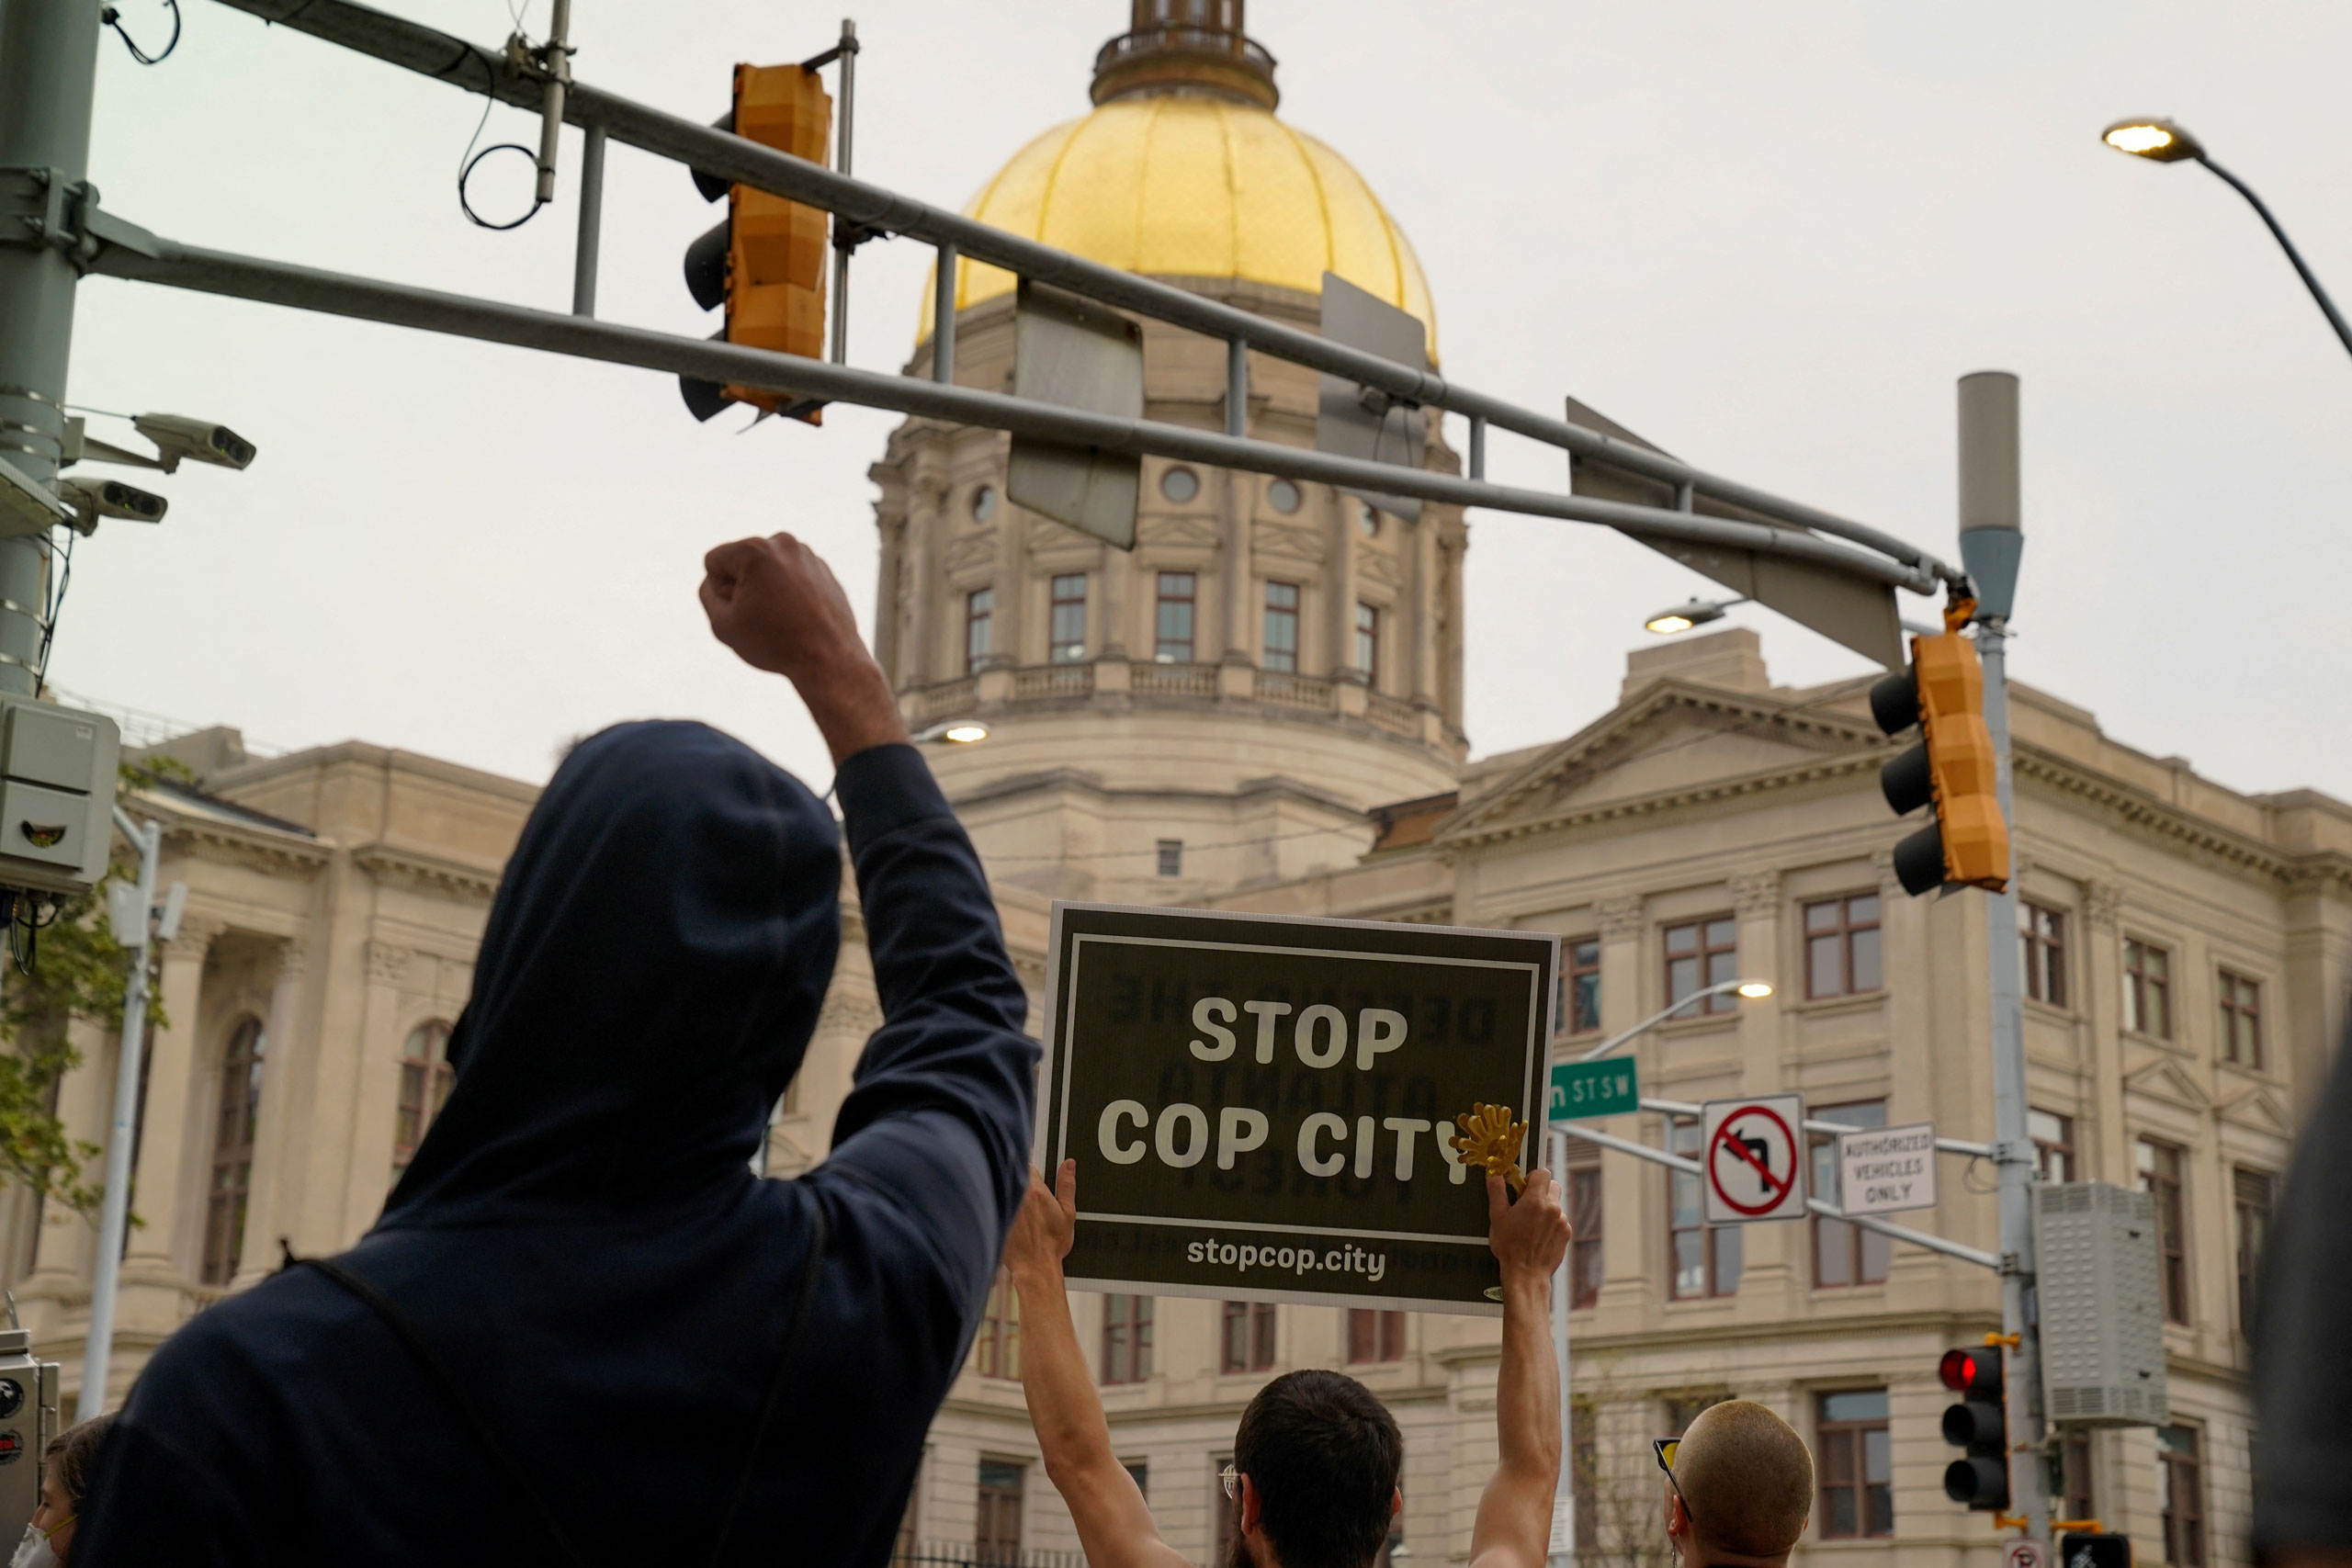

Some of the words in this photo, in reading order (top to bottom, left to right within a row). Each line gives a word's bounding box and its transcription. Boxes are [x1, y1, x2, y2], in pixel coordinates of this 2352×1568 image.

[1190, 998, 1408, 1070] STOP
[1573, 1077, 1596, 1102] ST
[1601, 1075, 1629, 1100] SW
[1098, 1100, 1269, 1170] COP
[1297, 1112, 1468, 1185] CITY
[1845, 1133, 1930, 1156] AUTHORIZED
[1854, 1157, 1924, 1181] VEHICLES
[1865, 1182, 1913, 1204] ONLY
[1188, 1238, 1385, 1281] stopcop.city
